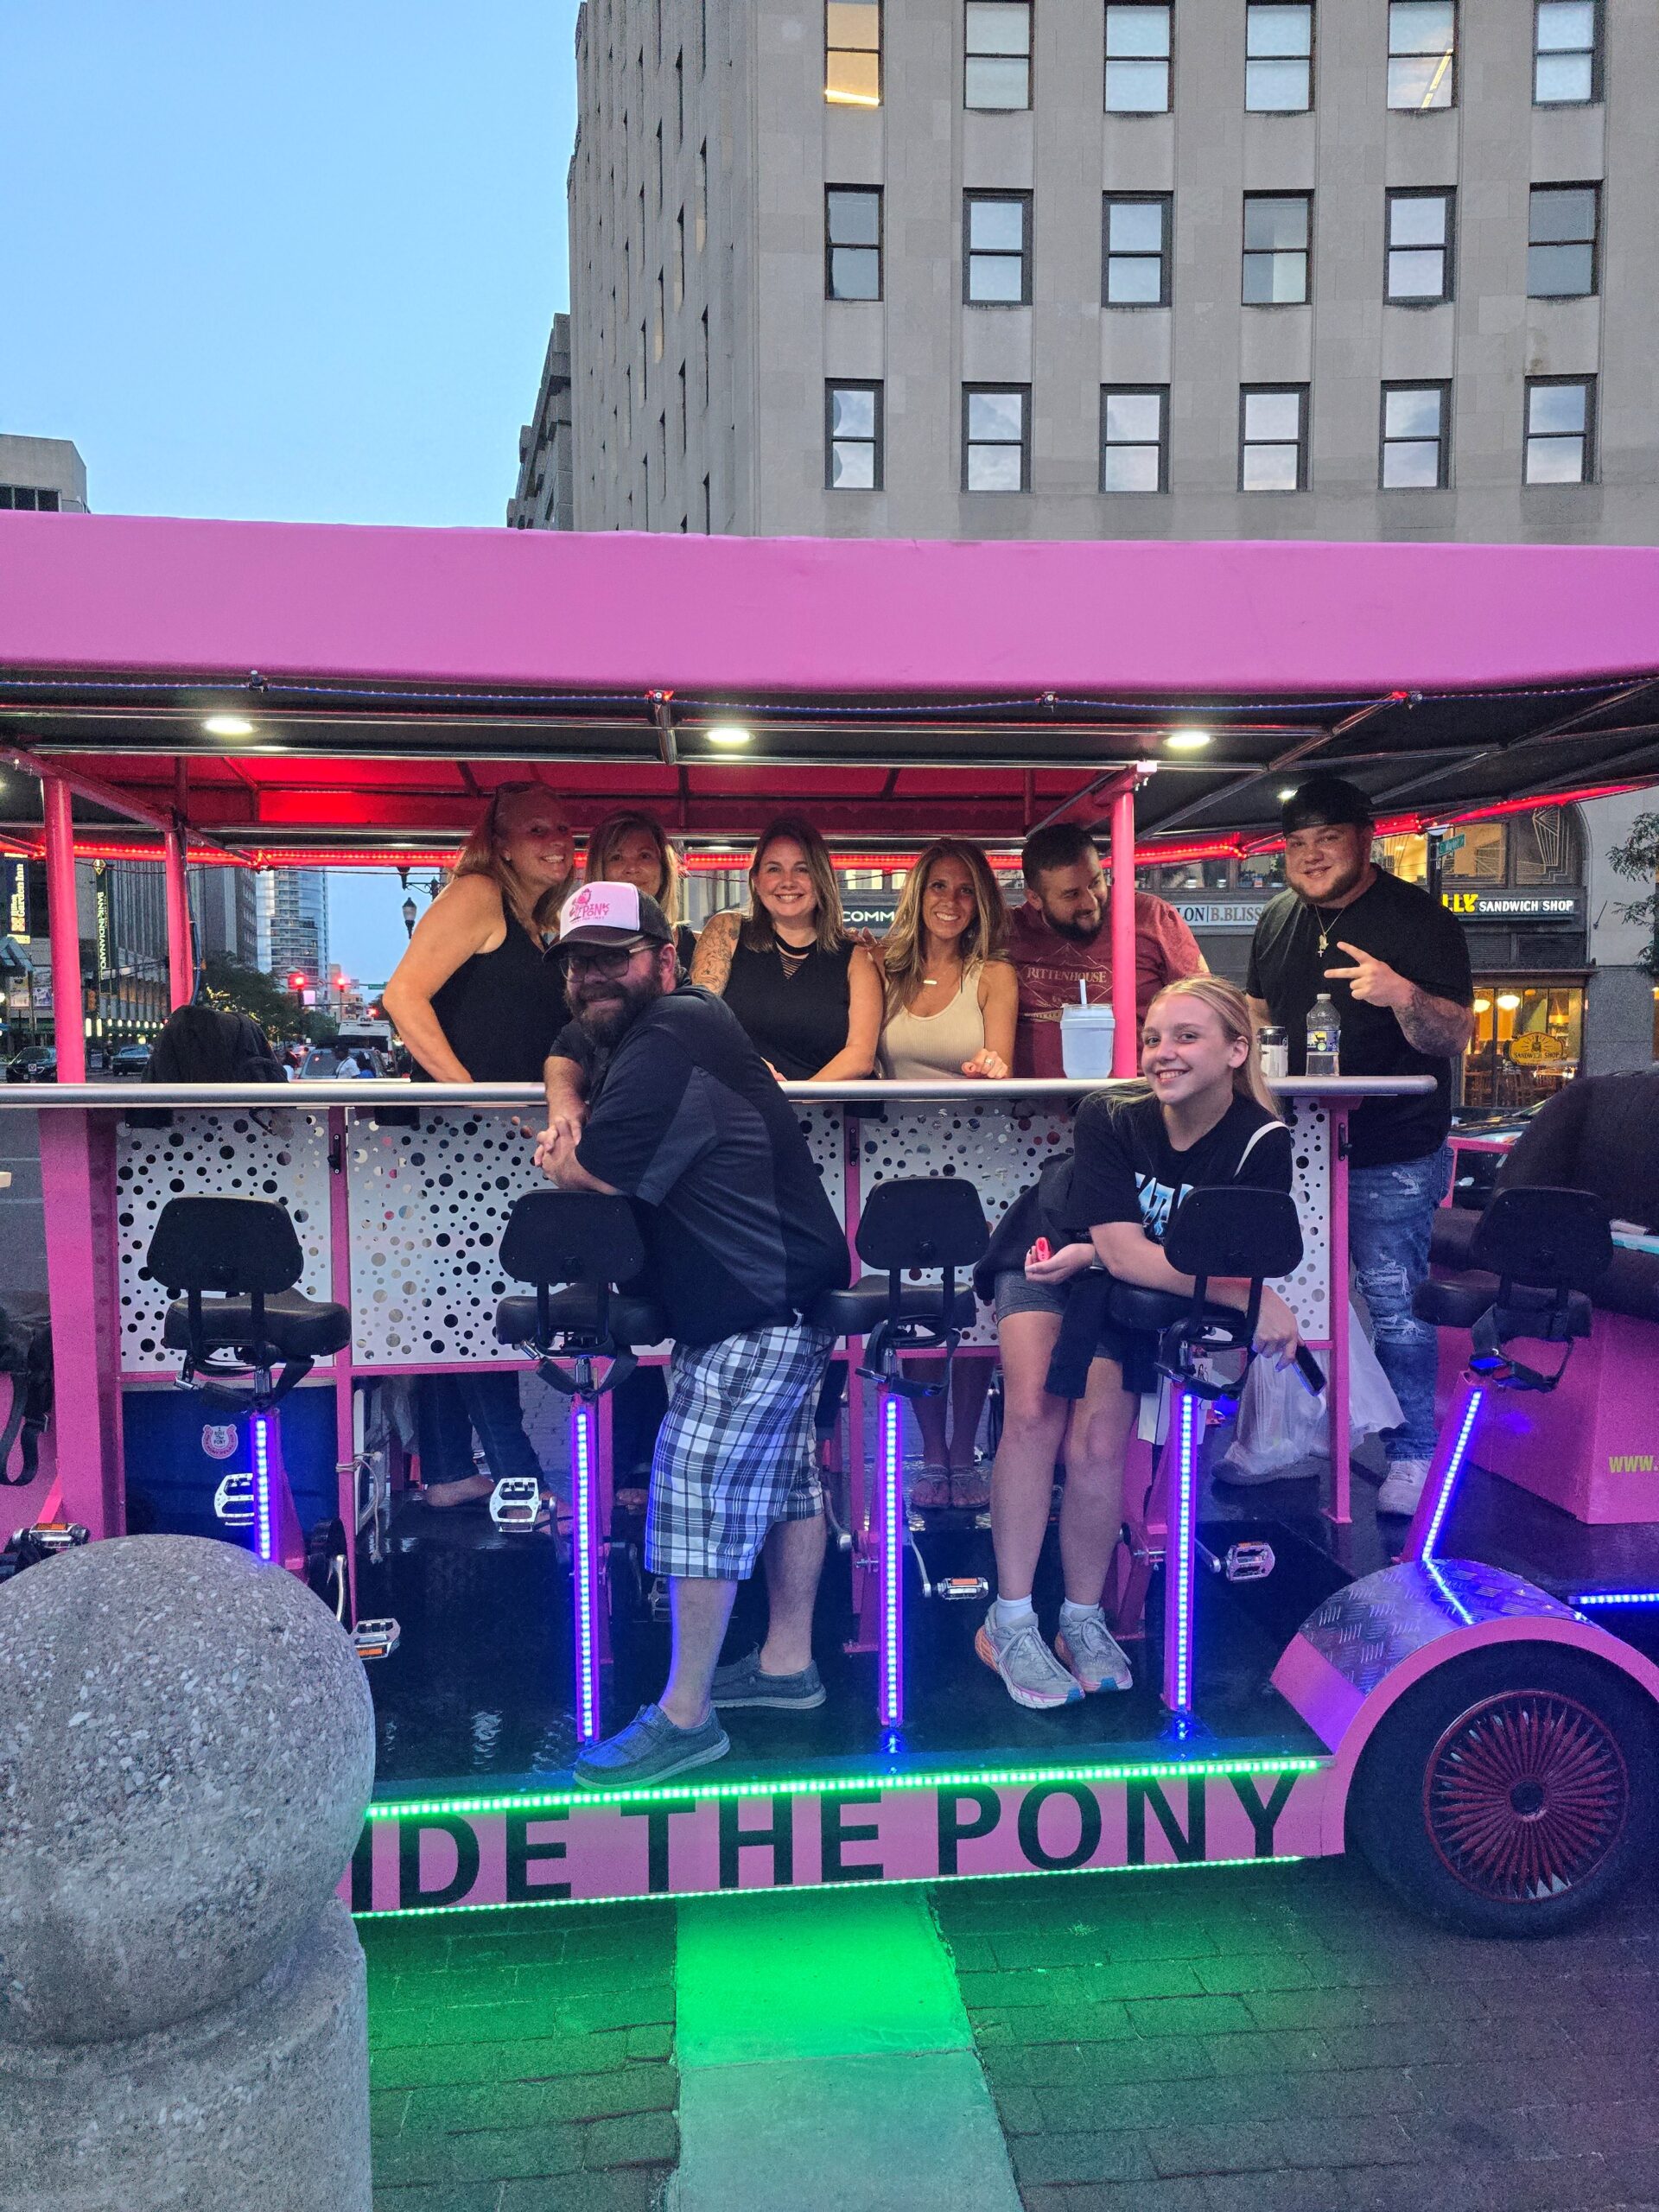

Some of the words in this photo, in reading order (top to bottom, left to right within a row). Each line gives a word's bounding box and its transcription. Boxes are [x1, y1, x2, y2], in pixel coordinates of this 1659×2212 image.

[16, 863, 24, 881] Inn
[16, 881, 25, 917] Garden
[1479, 900, 1539, 912] SANDWICH
[1542, 899, 1573, 912] SHOP
[842, 910, 895, 923] COMM
[1027, 967, 1107, 982] RITTENHOUSE
[620, 1788, 885, 1894] THE
[937, 1770, 1302, 1877] PONY
